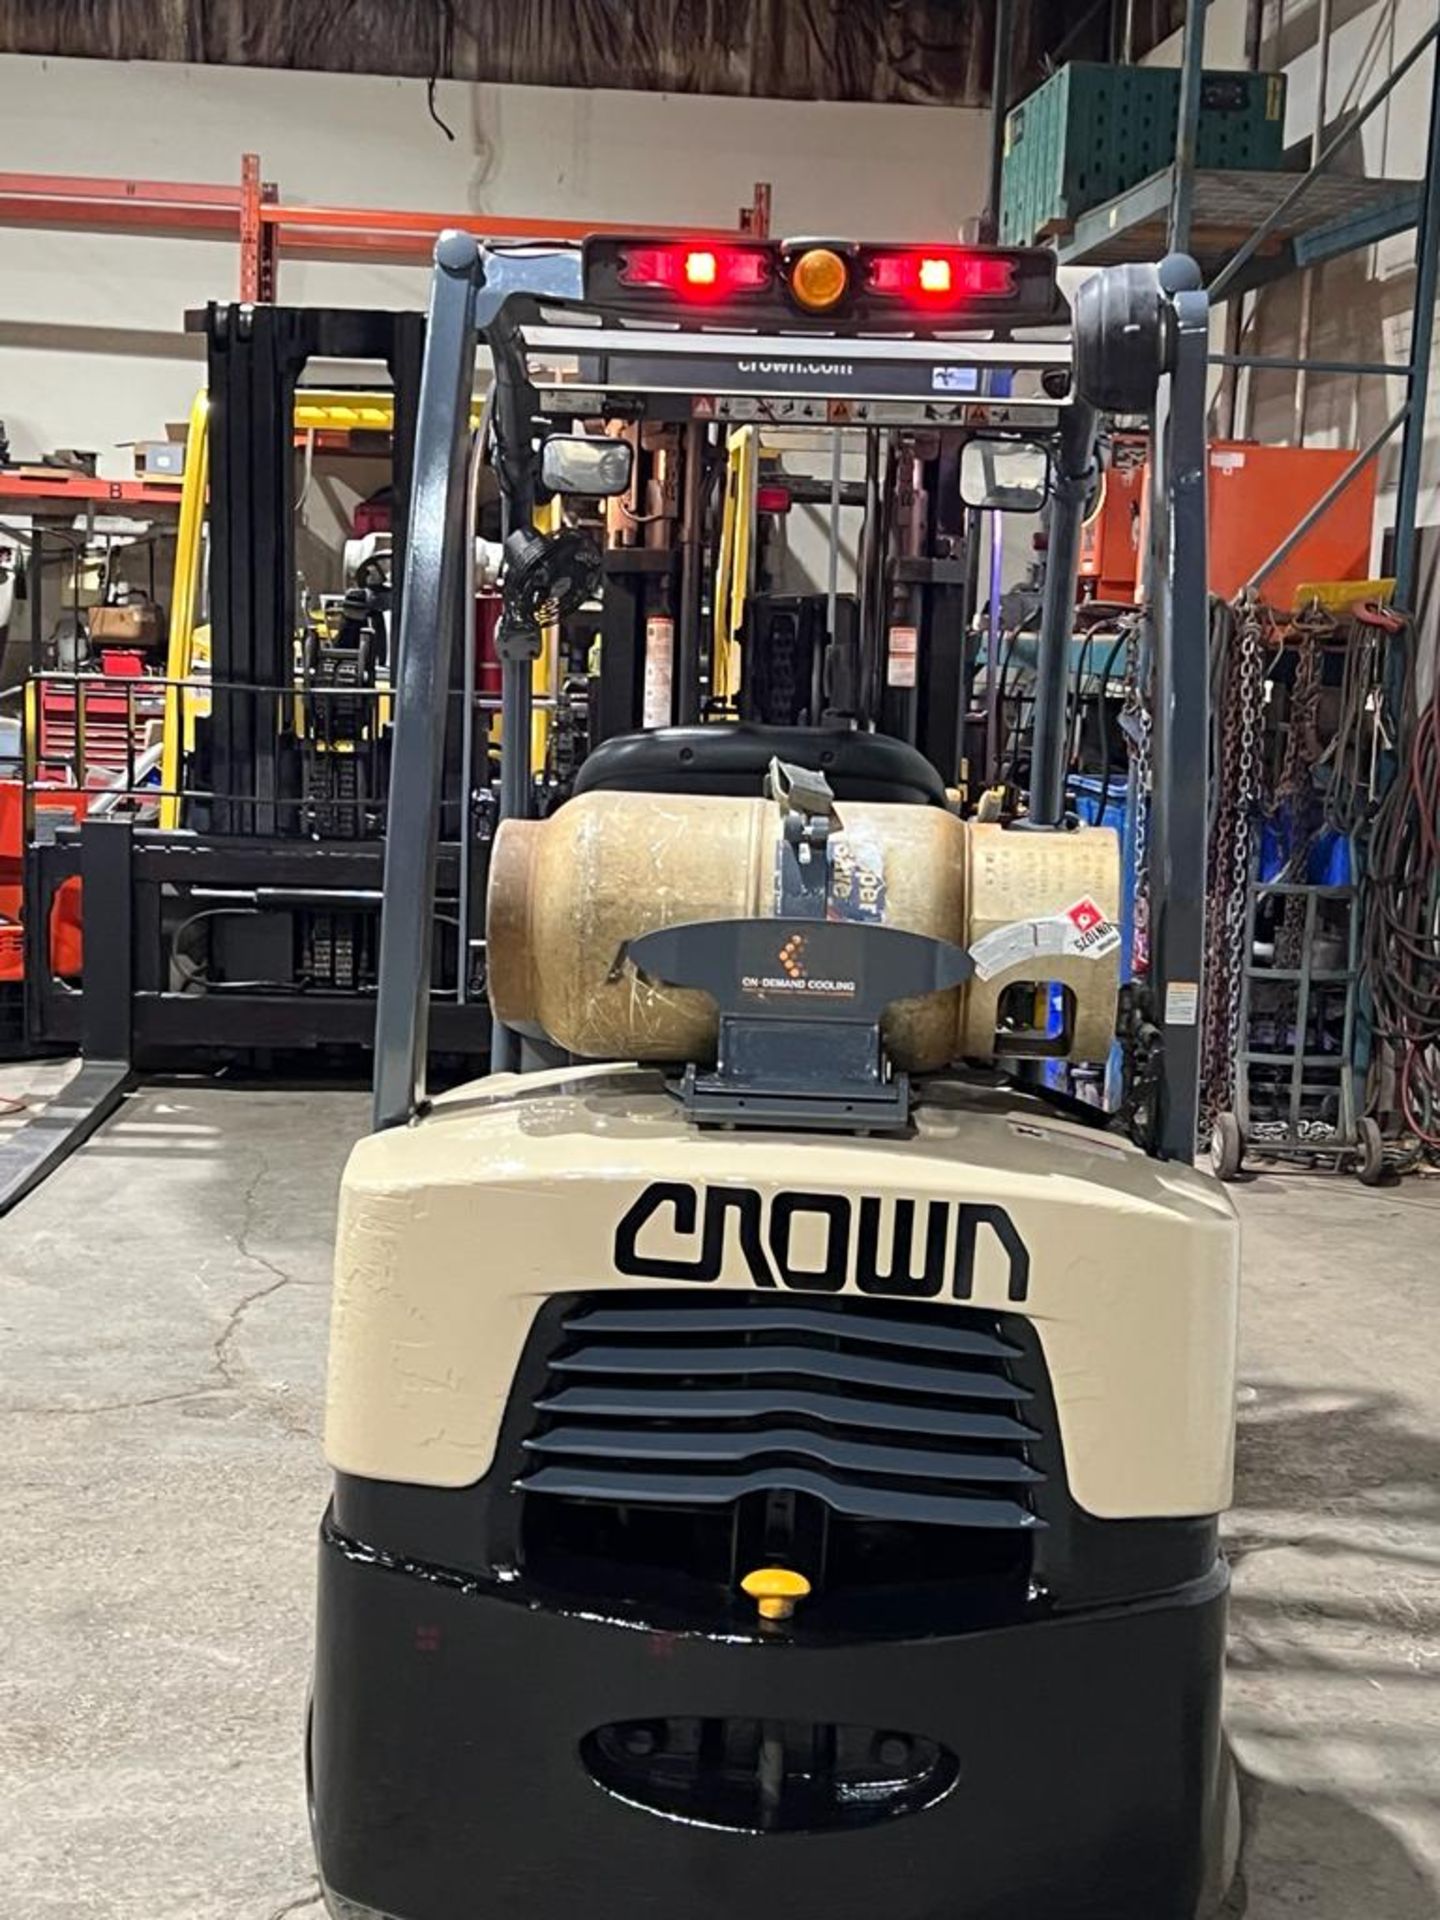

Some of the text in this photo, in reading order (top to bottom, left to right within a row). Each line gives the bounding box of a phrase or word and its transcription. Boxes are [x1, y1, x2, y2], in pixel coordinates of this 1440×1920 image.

[1073, 922, 1113, 952] UN1075
[742, 976, 856, 991] ON-DEMAND COOLING
[614, 1181, 1030, 1302] CROWN
